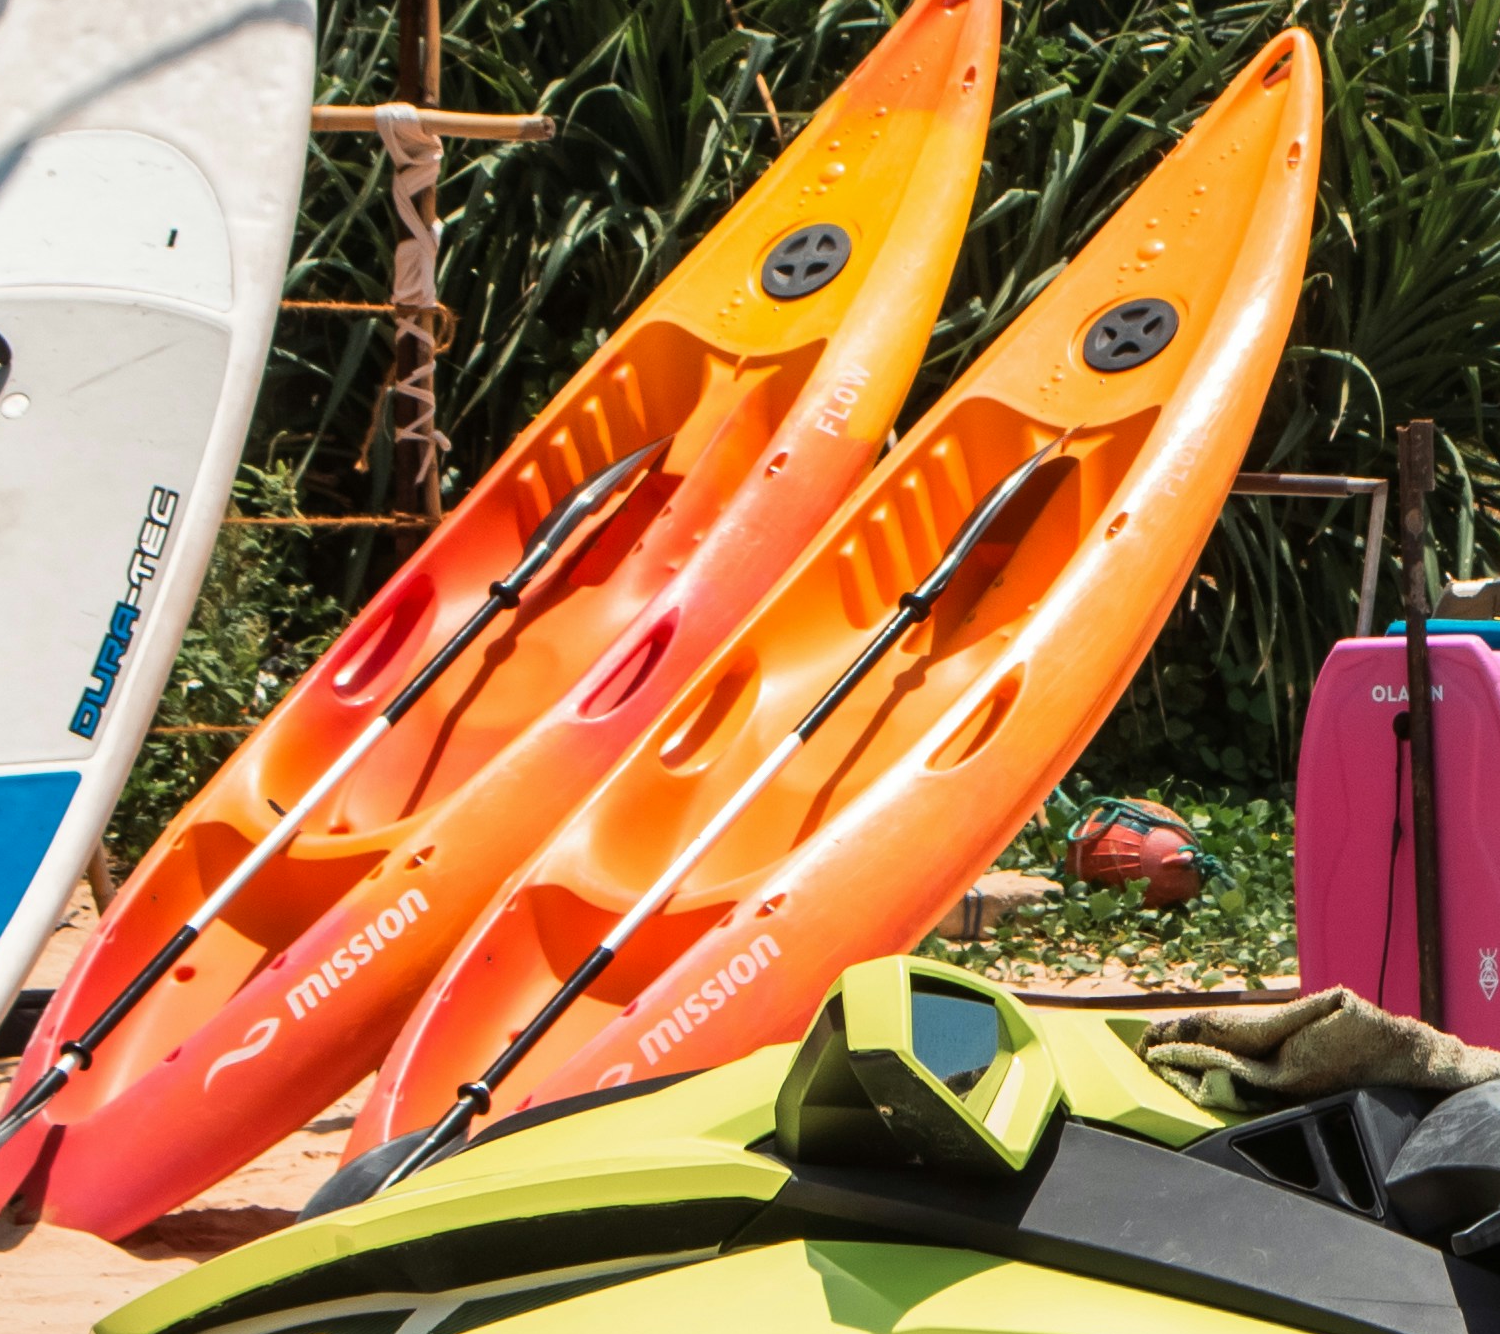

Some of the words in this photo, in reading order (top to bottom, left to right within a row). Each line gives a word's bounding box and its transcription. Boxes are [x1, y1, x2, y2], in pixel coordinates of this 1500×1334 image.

[815, 363, 873, 438] FLOW
[68, 486, 180, 741] DURA-TEC
[1371, 685, 1444, 703] OLAN
[285, 888, 431, 1021] mission
[637, 932, 783, 1067] mission
